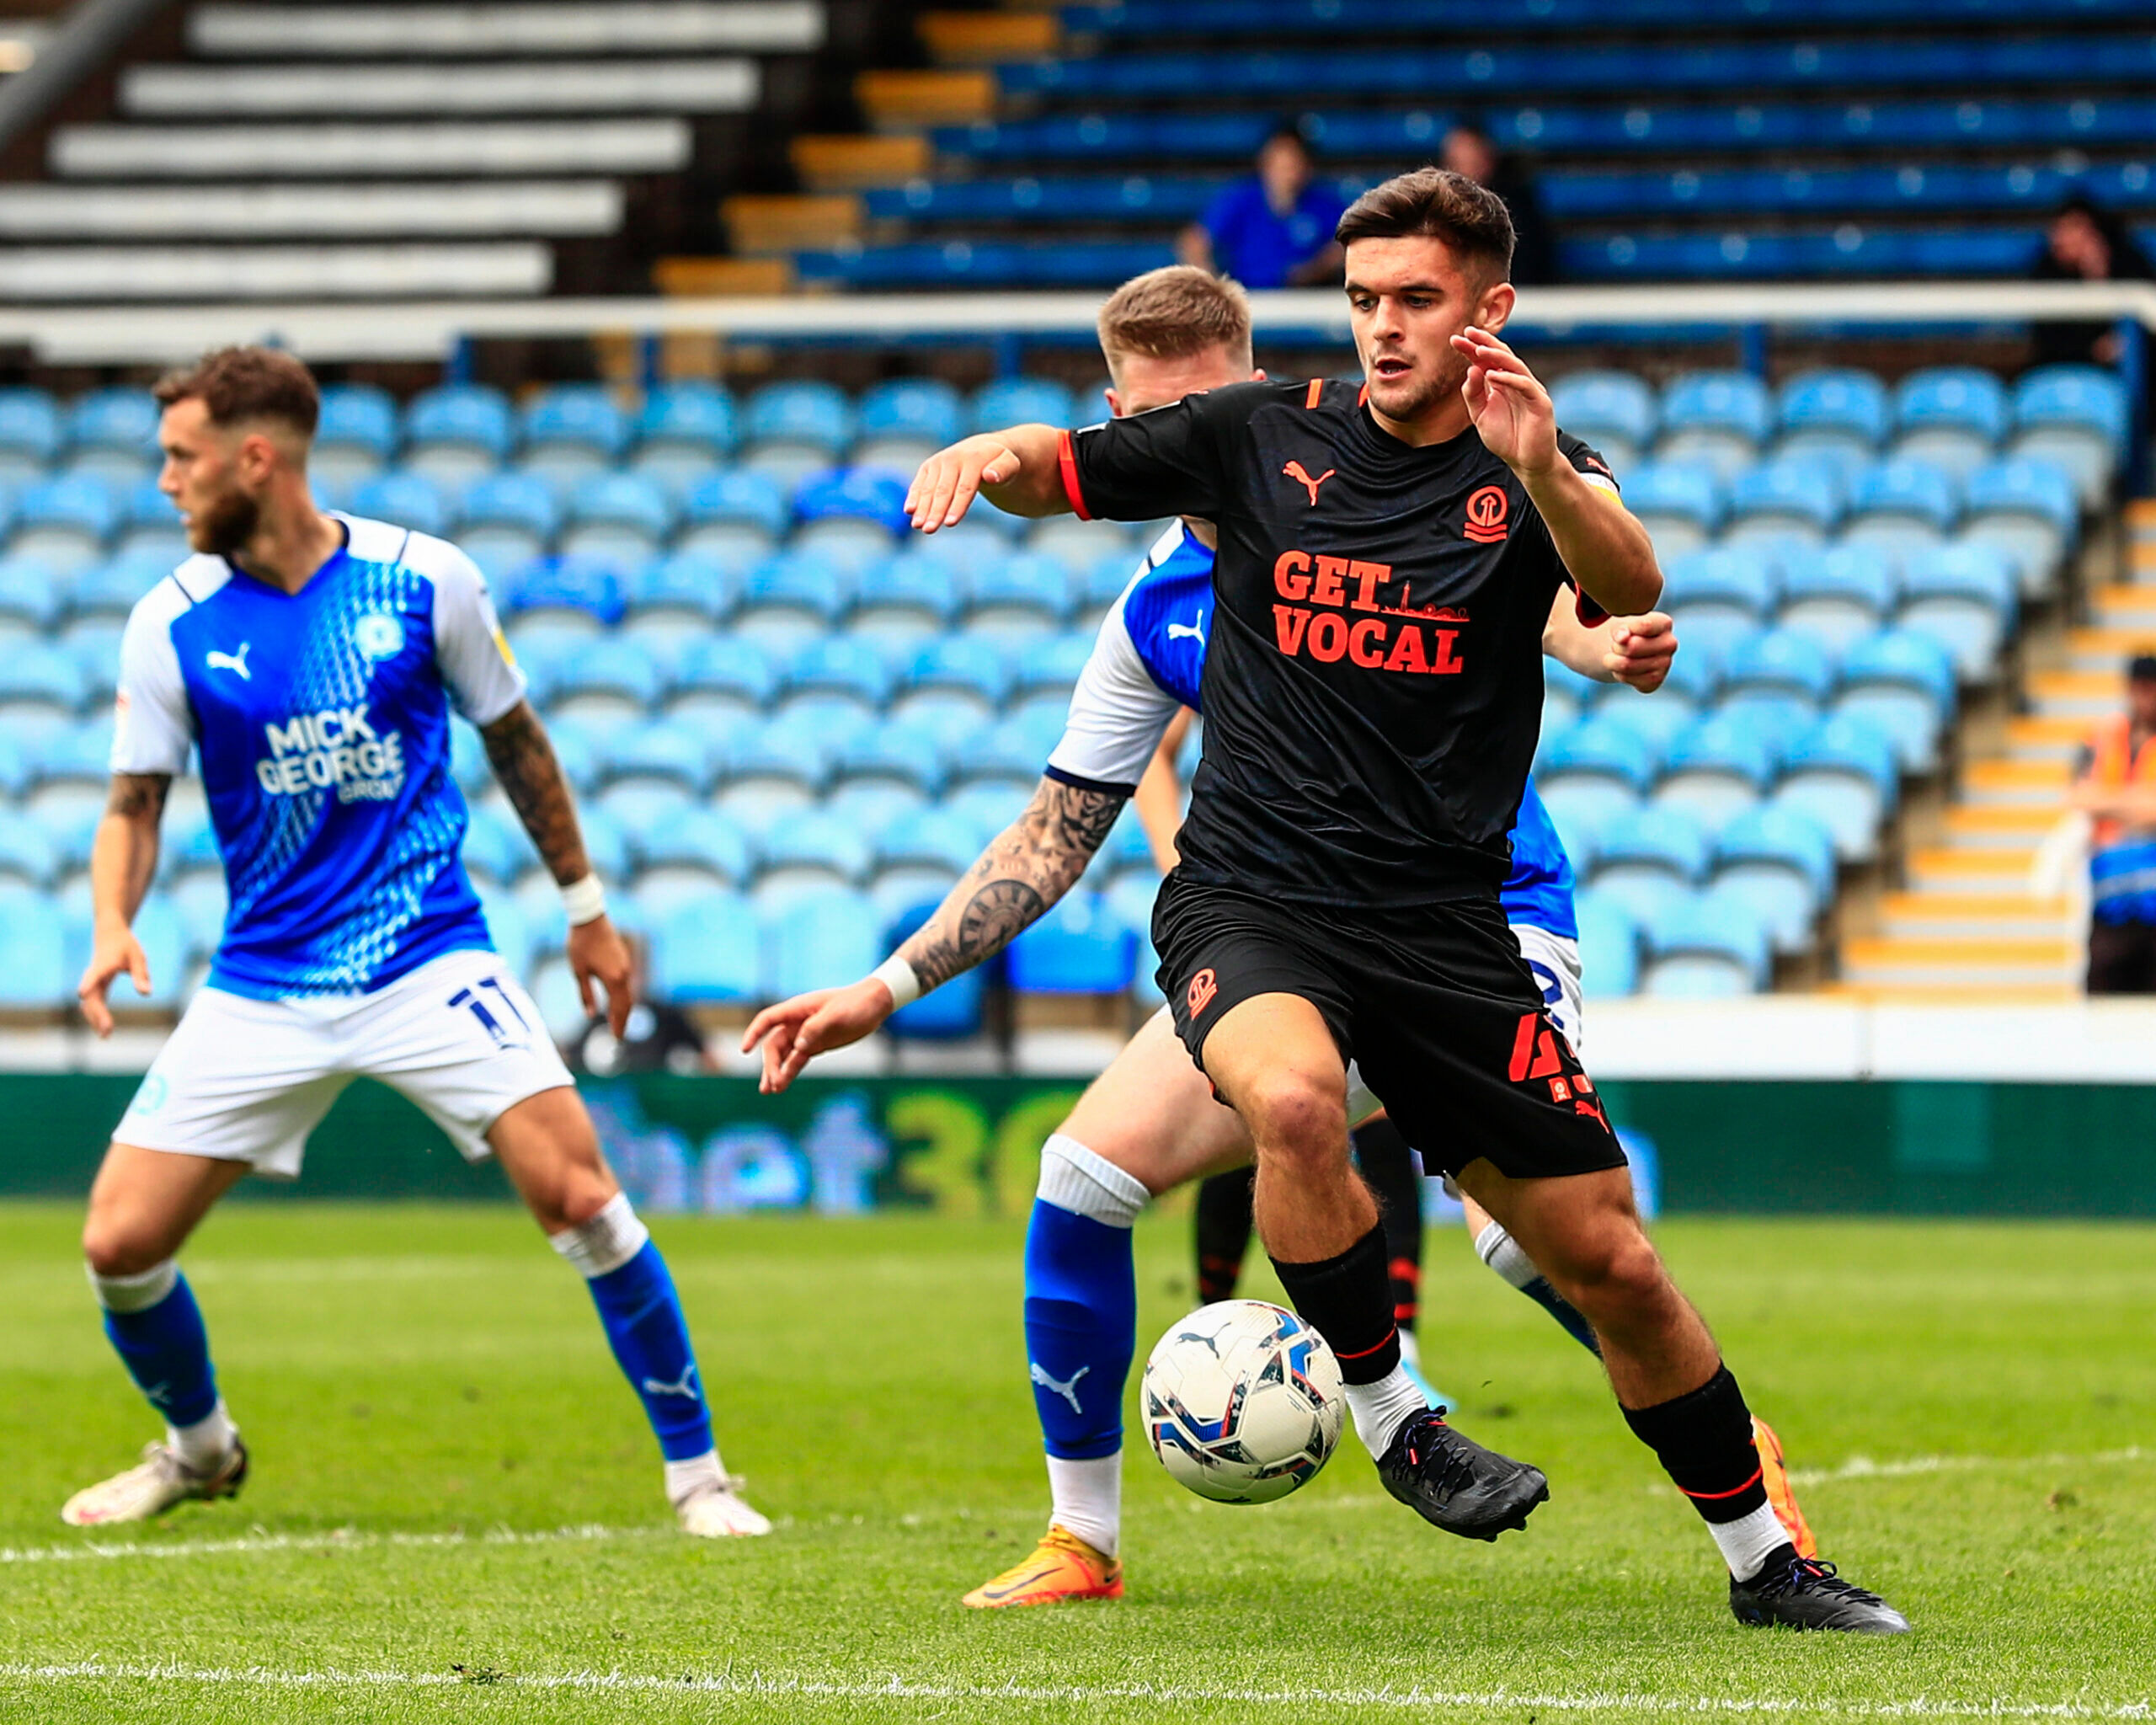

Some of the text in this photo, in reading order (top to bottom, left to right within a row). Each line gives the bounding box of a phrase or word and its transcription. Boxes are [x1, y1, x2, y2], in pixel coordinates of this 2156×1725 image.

[1273, 549, 1392, 612] GET
[1273, 603, 1465, 674] VOCAL
[256, 729, 403, 794] GEORGE
[264, 702, 376, 759] MICK
